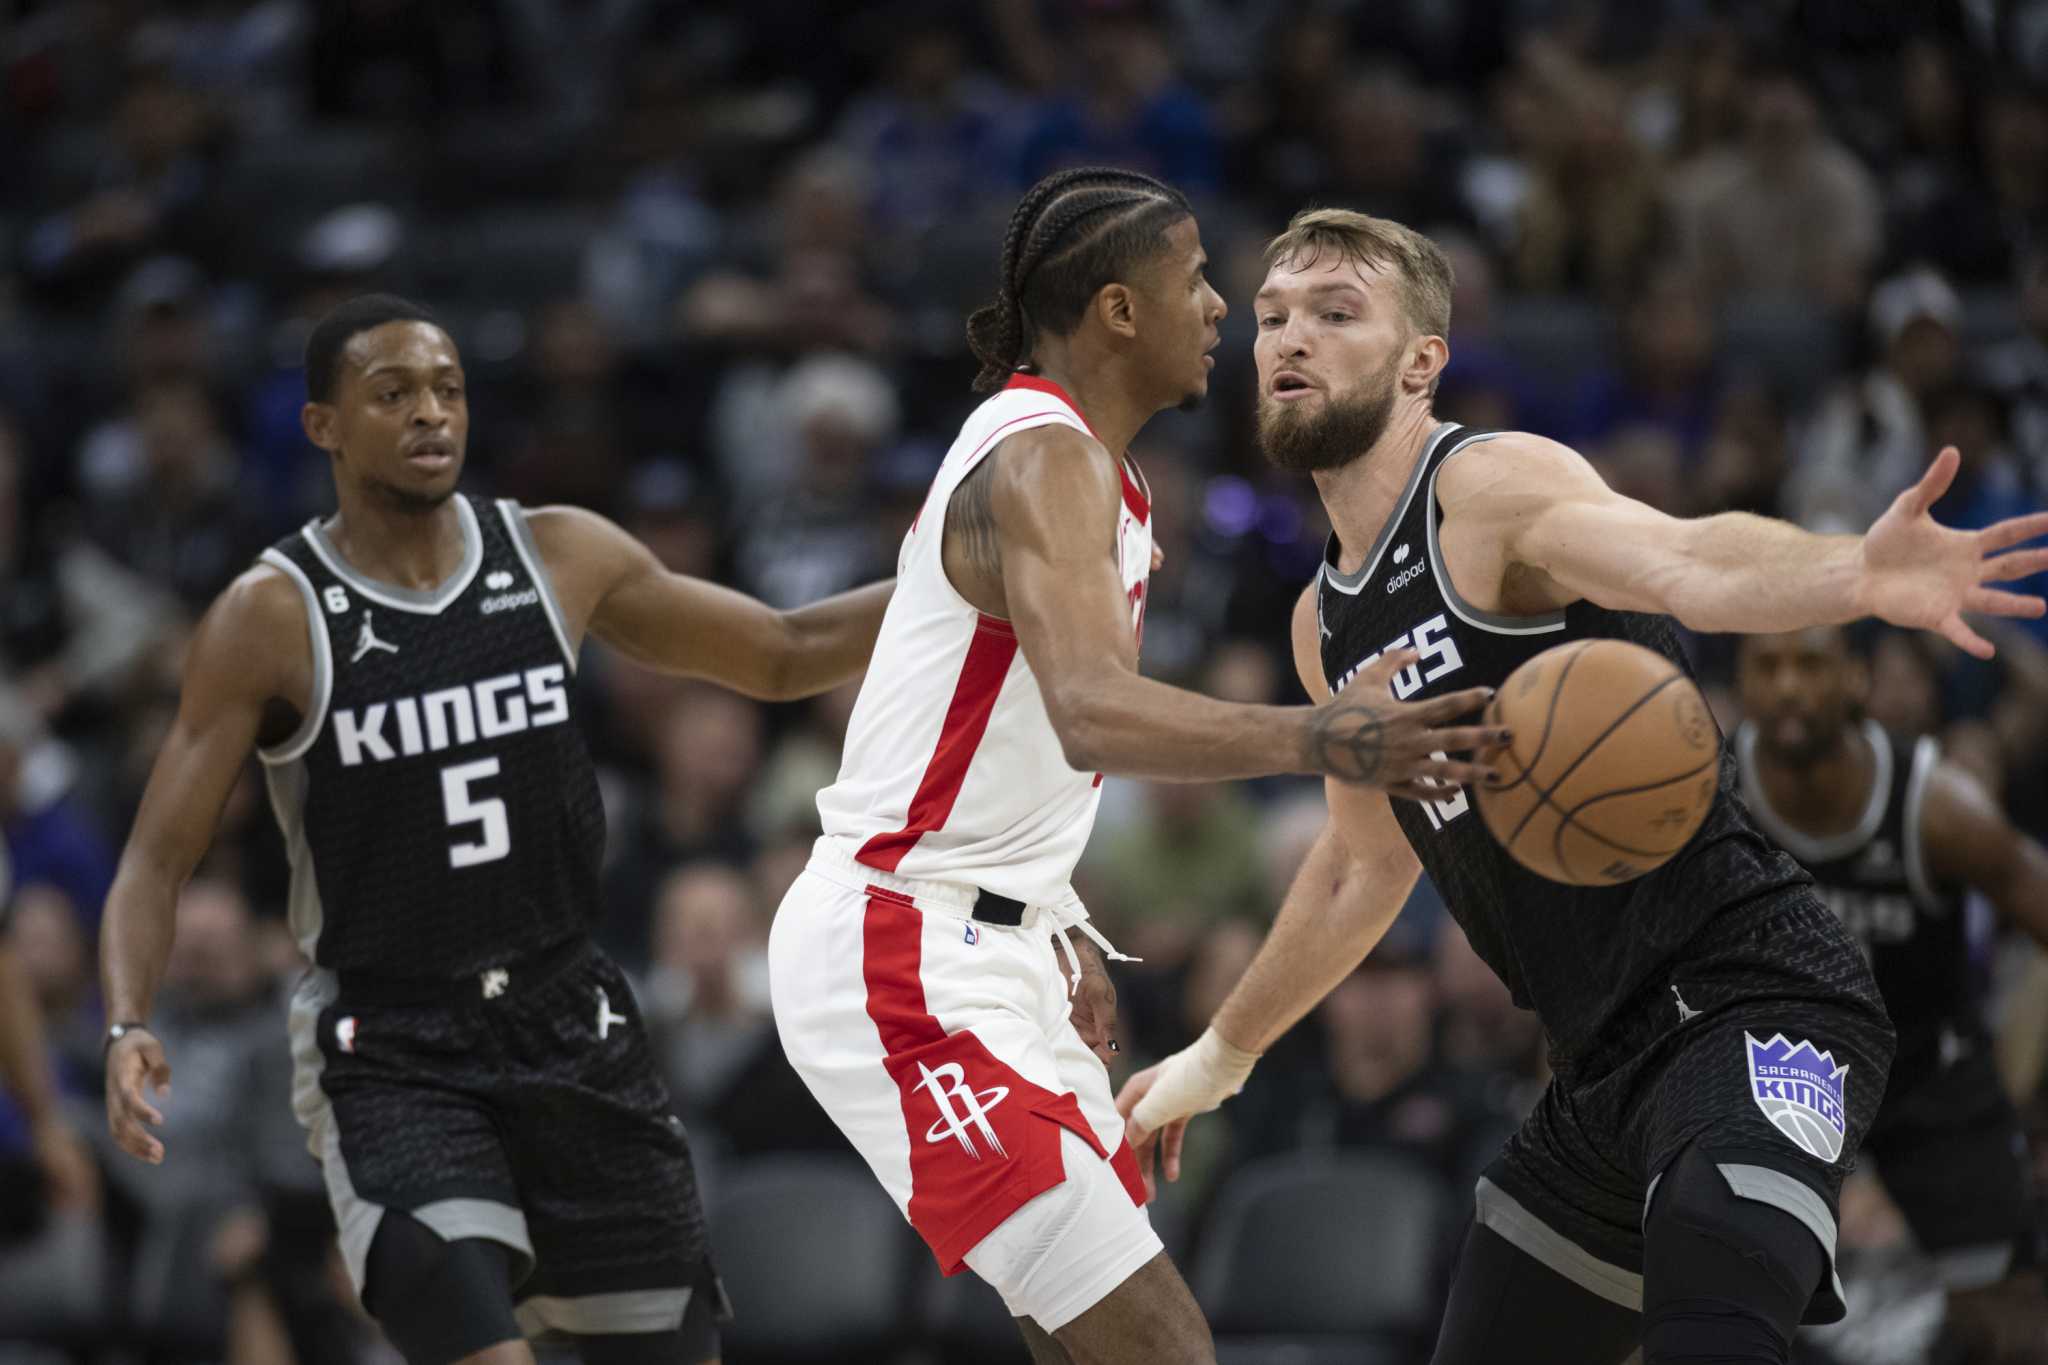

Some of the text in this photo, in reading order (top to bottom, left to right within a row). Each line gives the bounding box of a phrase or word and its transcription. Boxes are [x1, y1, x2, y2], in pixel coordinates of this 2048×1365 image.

[323, 585, 350, 614] 6
[1387, 556, 1425, 594] dialpad
[333, 664, 569, 766] KINGS
[441, 756, 511, 868] 5
[1756, 1080, 1844, 1134] KINGS
